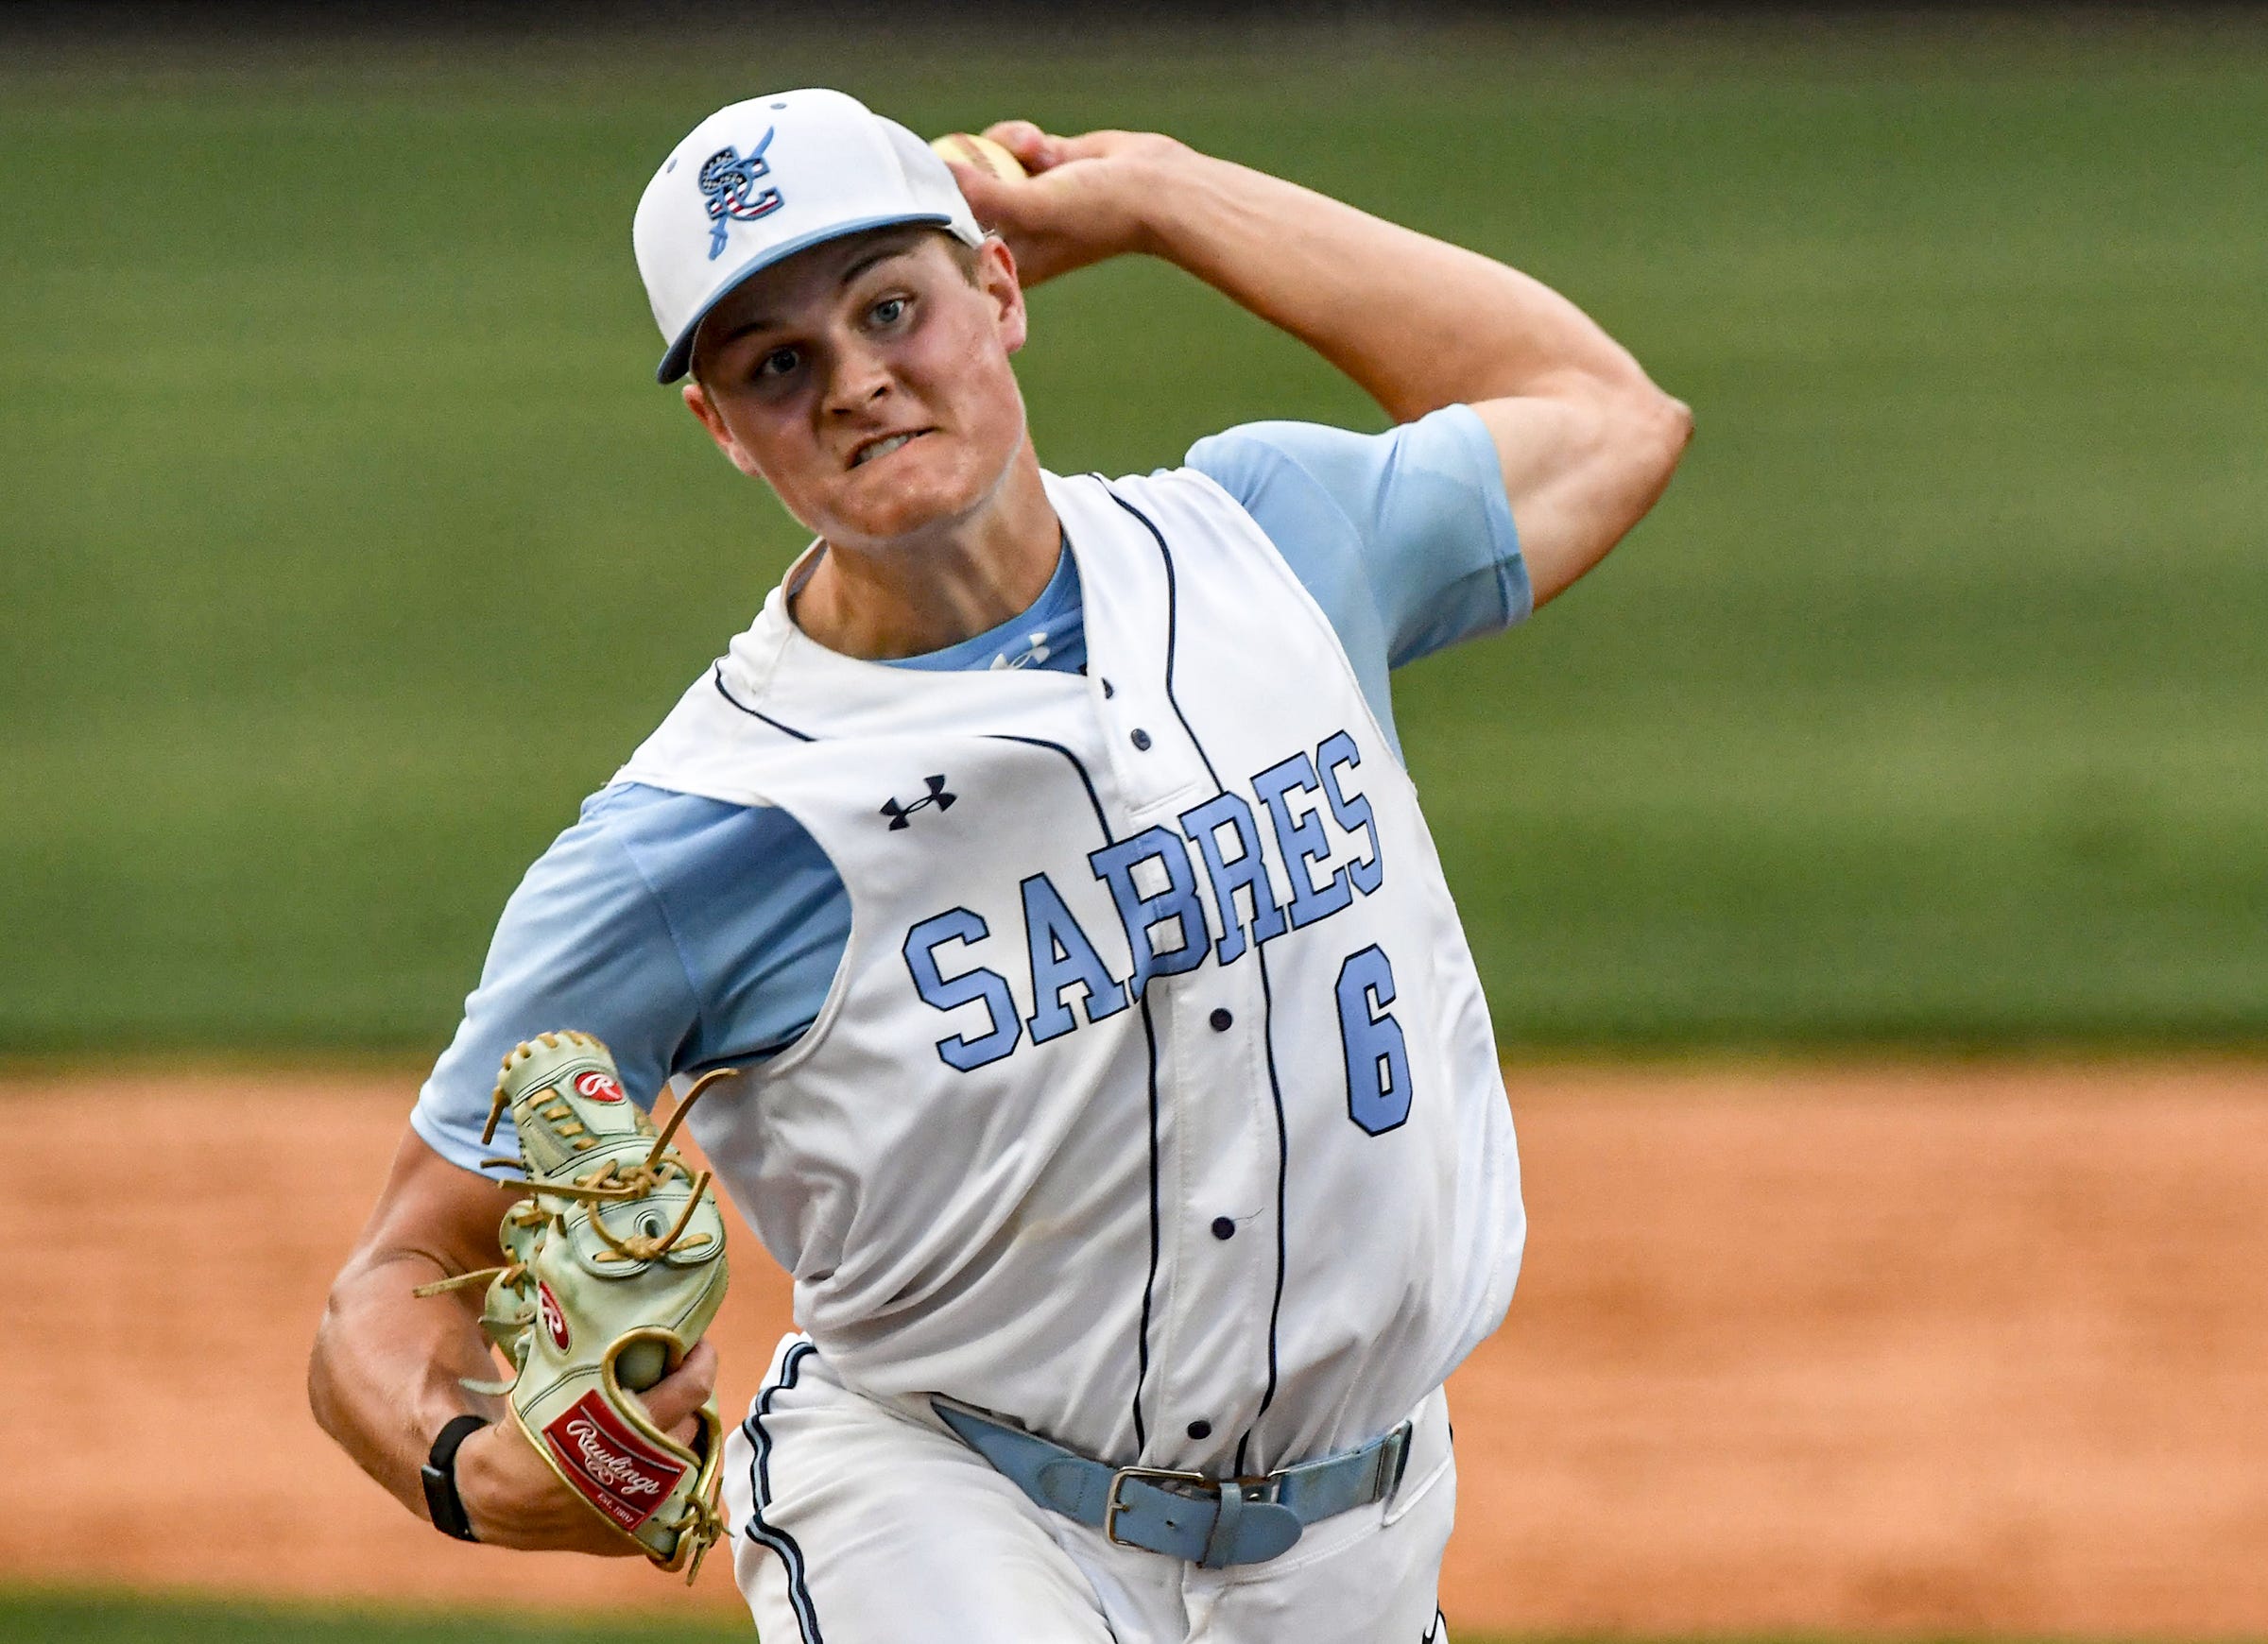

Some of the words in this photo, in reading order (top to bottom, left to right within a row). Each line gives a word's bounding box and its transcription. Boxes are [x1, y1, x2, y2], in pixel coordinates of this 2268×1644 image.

[902, 728, 1383, 1074] SABRES
[1334, 943, 1414, 1138] 6
[566, 1419, 660, 1495] Rawlings
